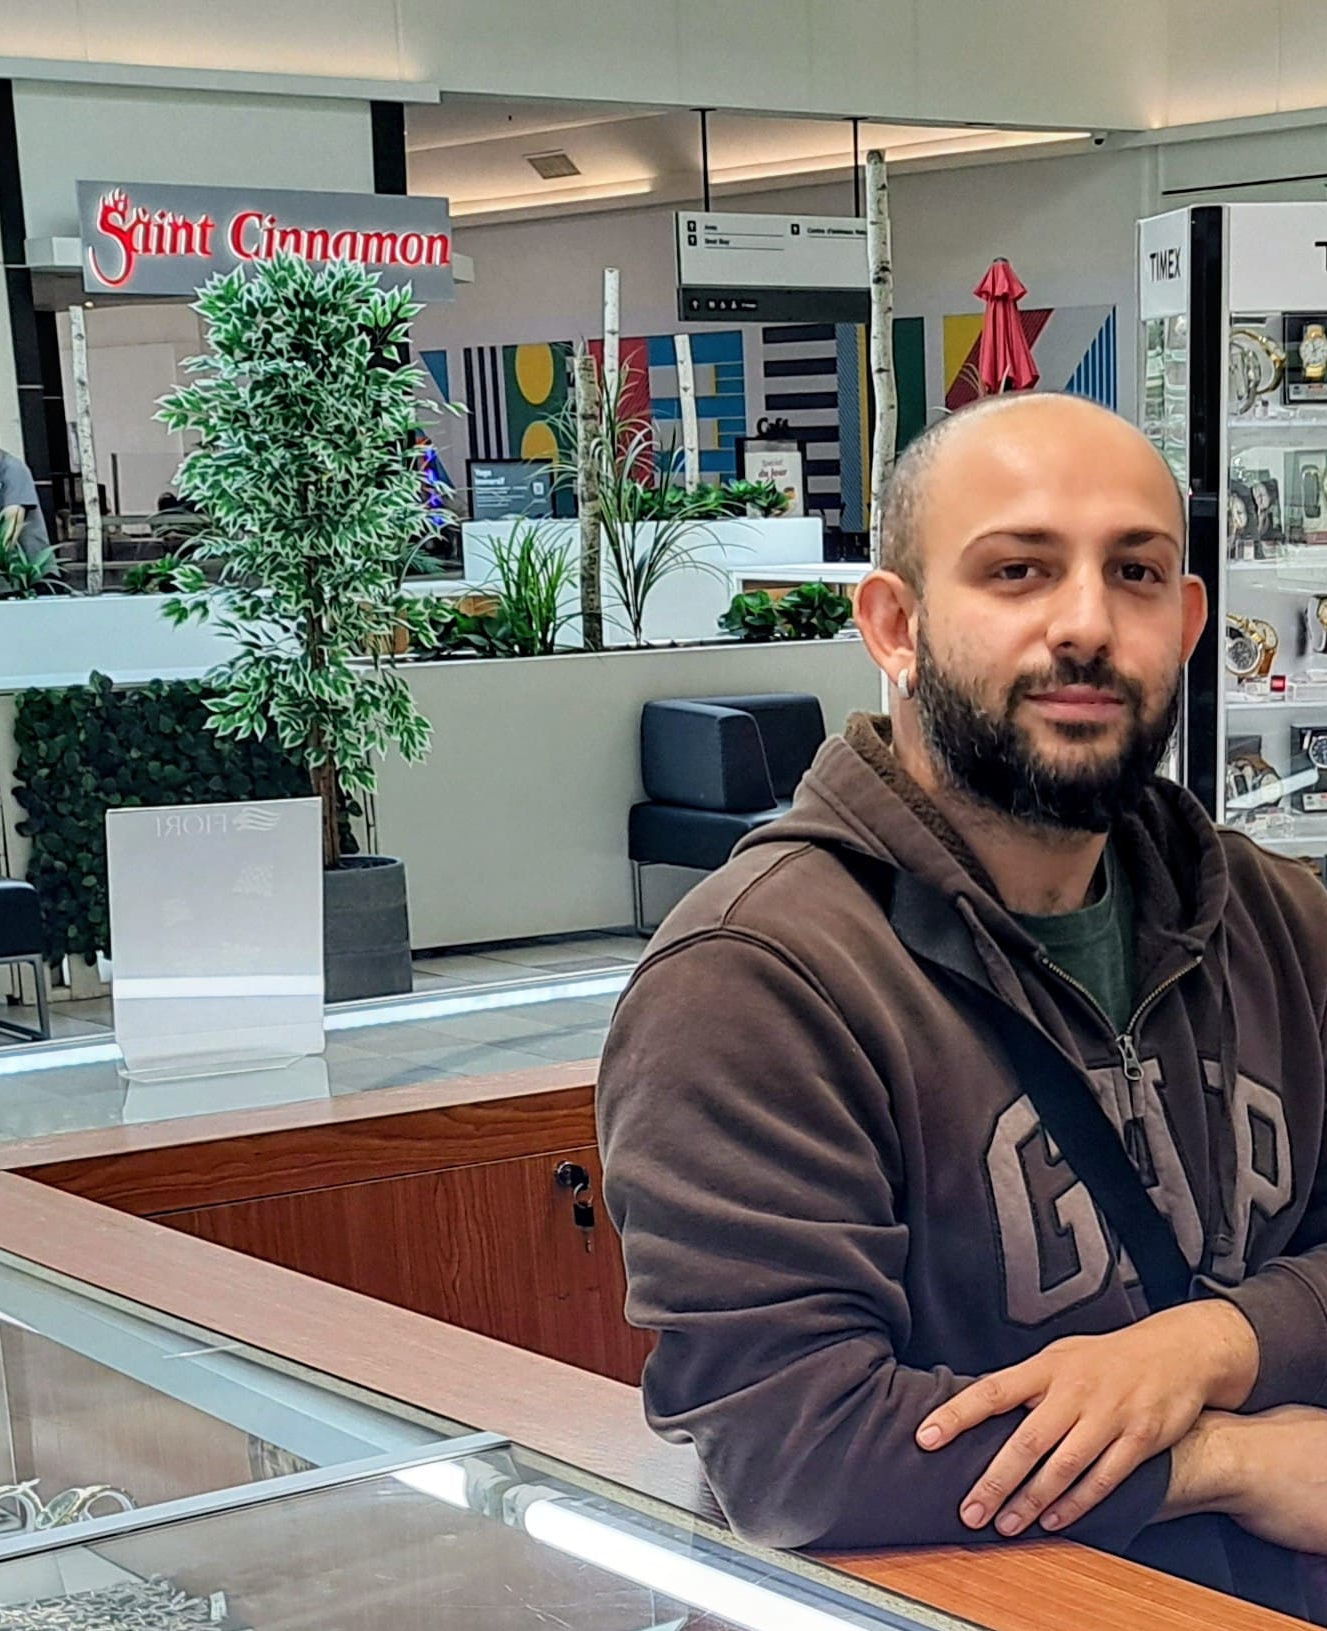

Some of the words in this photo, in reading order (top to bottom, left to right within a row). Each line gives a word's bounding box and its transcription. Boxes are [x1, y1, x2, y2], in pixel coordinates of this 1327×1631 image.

[89, 188, 215, 288] Saint
[229, 212, 450, 265] Cinnamon
[1149, 248, 1182, 281] TIMEX
